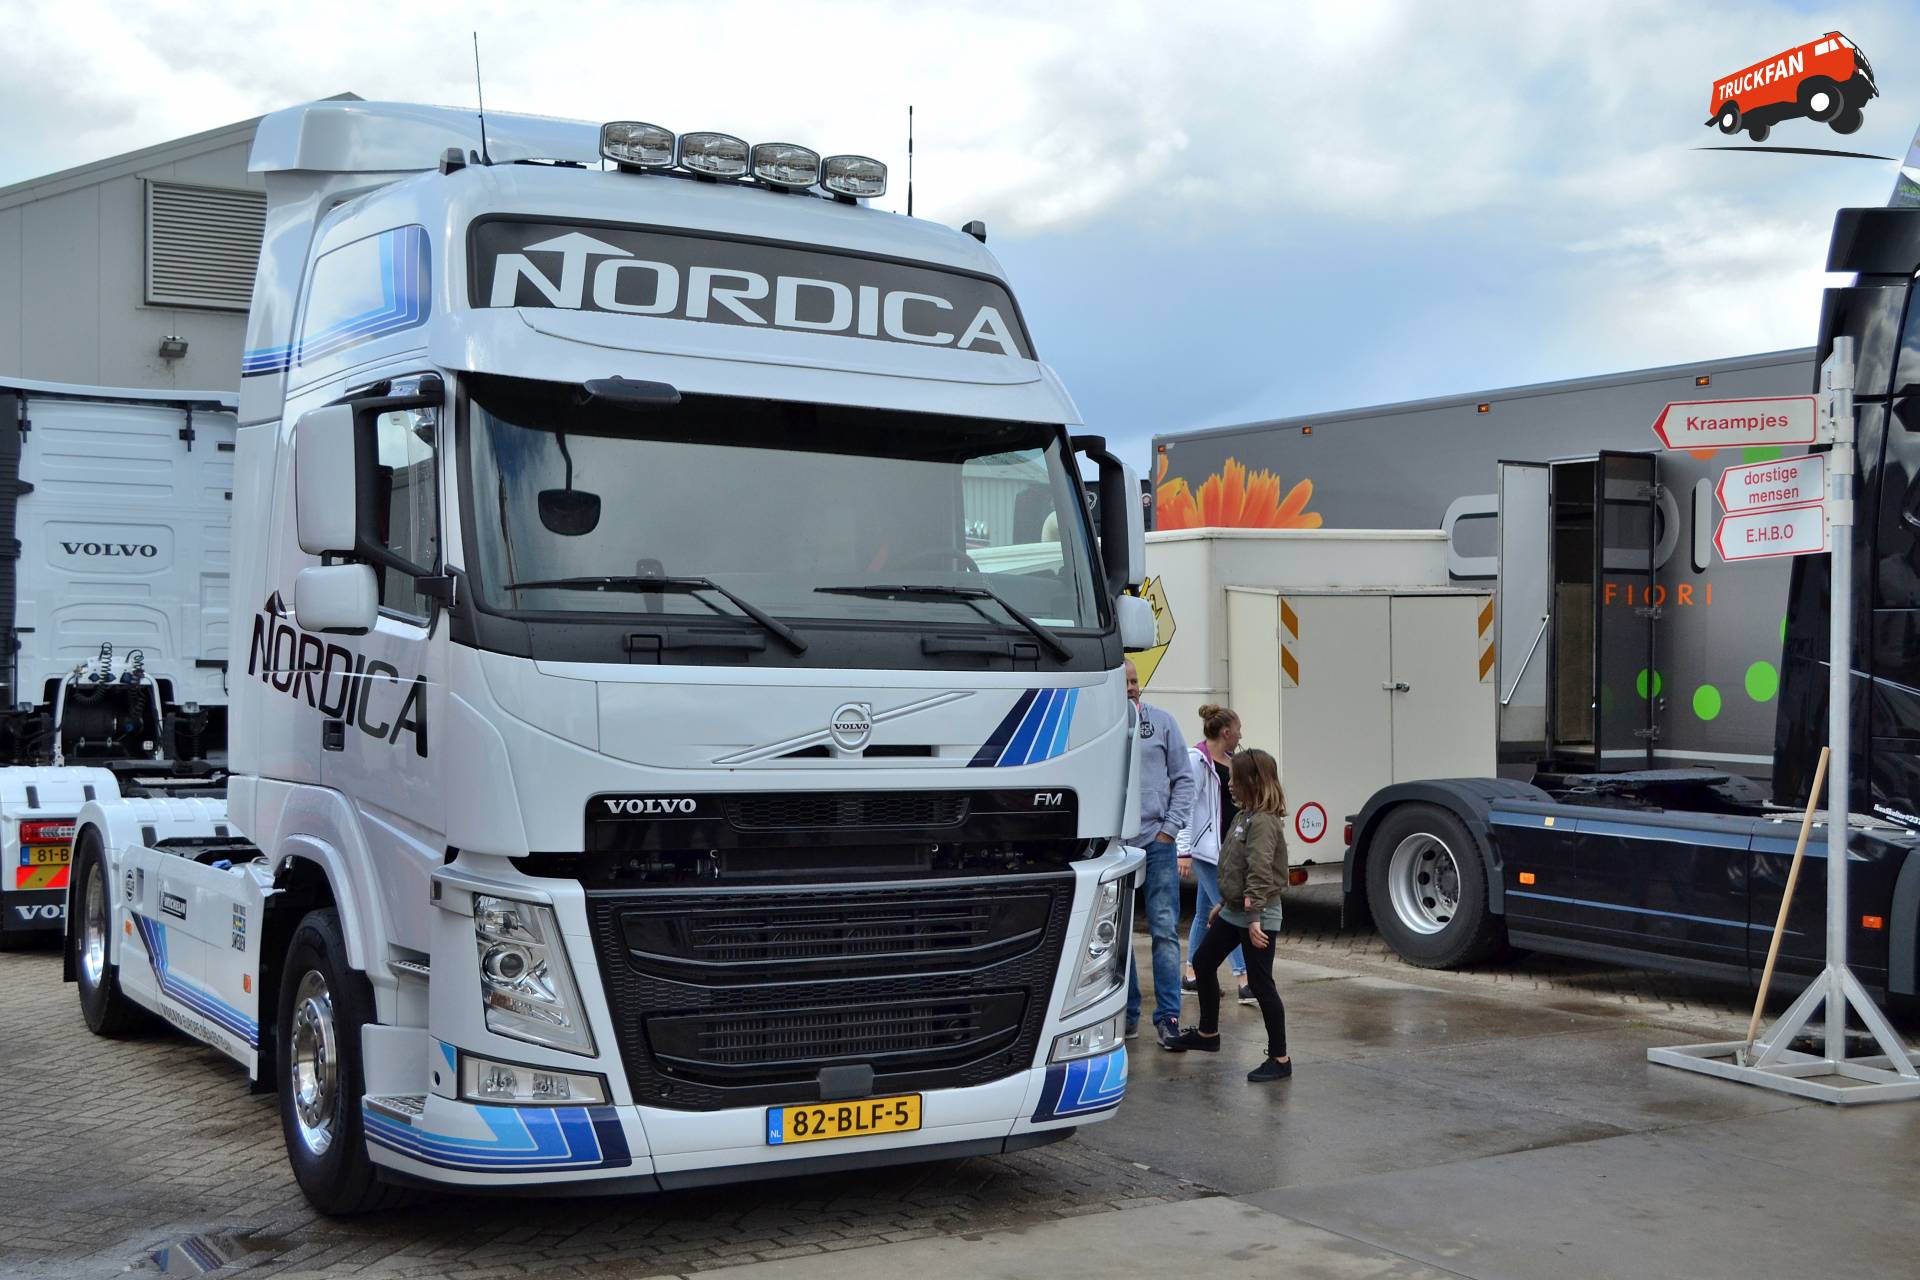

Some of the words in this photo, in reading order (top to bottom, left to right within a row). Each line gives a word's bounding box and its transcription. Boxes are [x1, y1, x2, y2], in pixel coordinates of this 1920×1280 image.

[490, 232, 1022, 359] NORDICA
[1686, 413, 1789, 432] Kraampjes
[1744, 466, 1798, 486] dorstige
[1748, 486, 1799, 504] mensen
[1746, 524, 1794, 543] E.H.B.O
[60, 541, 159, 559] VOLVO
[1605, 583, 1713, 607] FIORI
[248, 589, 428, 758] NORDICA
[604, 798, 698, 815] VOLVO
[1033, 792, 1063, 806] FM
[770, 1130, 782, 1138] NL
[793, 1101, 909, 1136] 82-BLF-5
